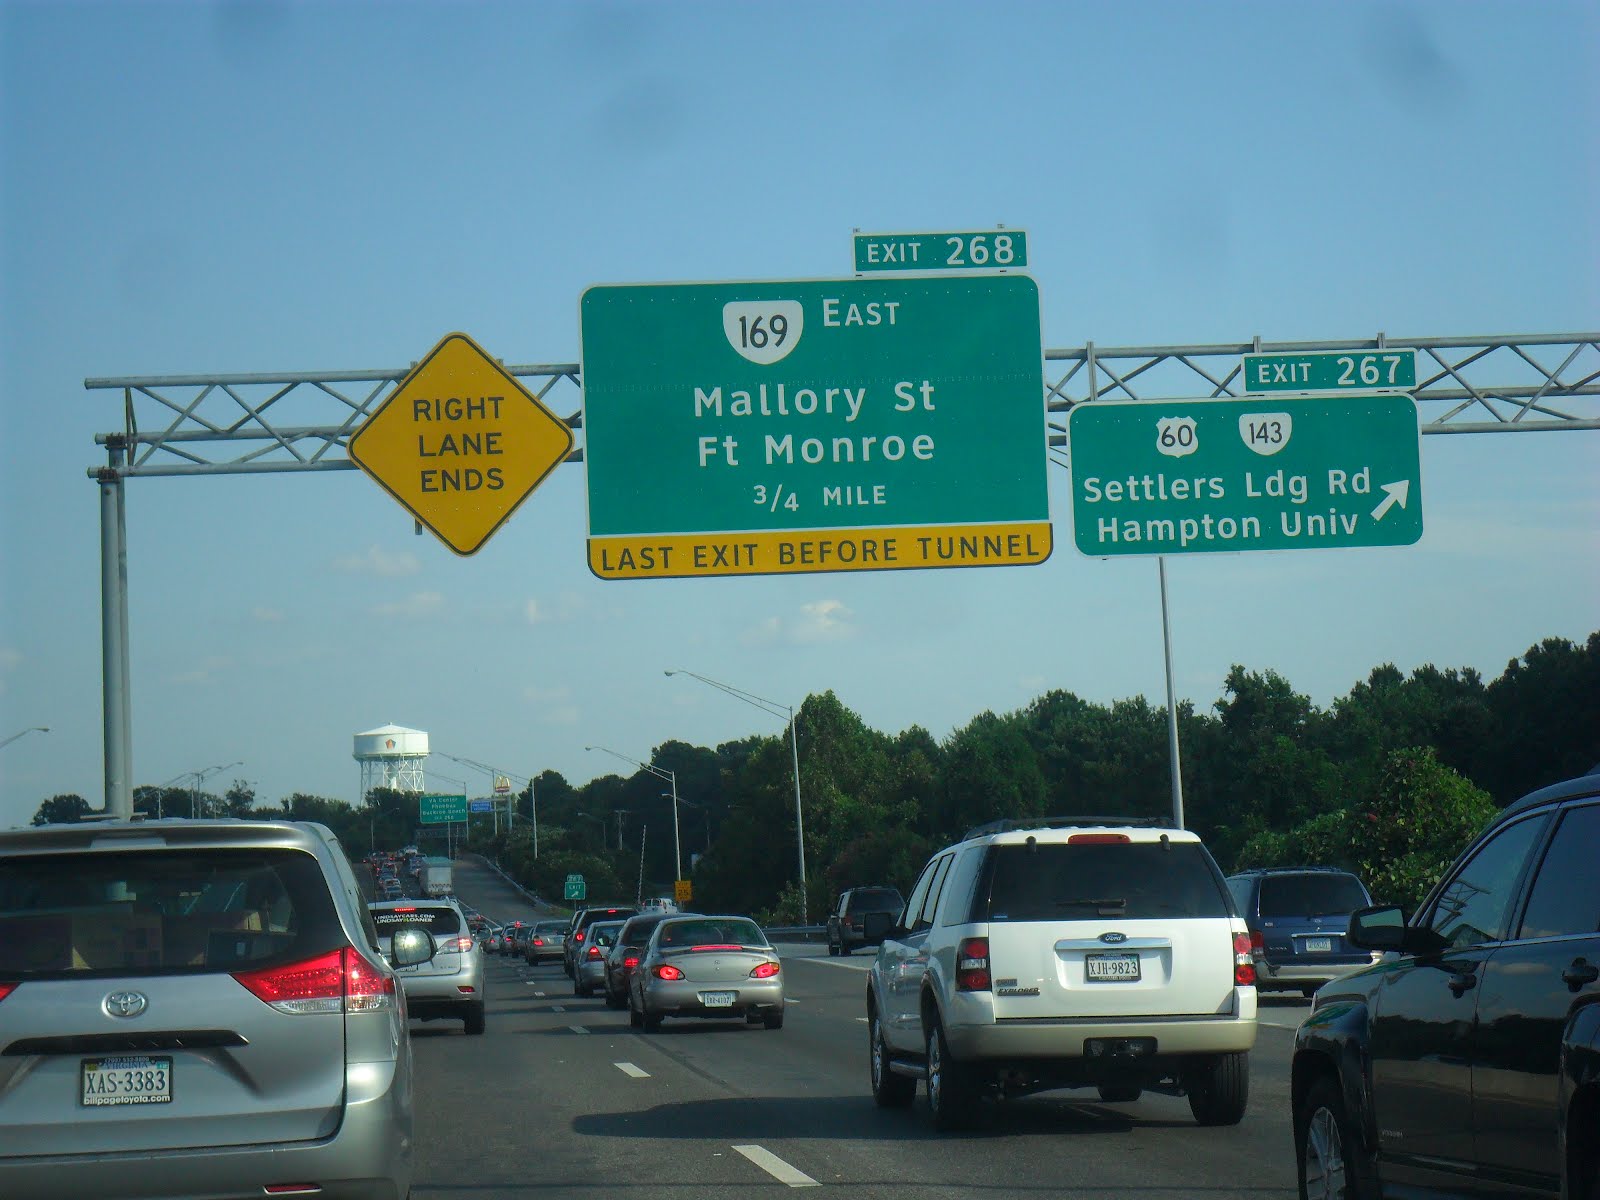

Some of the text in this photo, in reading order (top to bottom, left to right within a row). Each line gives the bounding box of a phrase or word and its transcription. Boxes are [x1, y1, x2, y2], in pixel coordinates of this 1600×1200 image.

[867, 235, 1015, 266] EXIT 268
[739, 298, 900, 350] 169 EAST
[1257, 355, 1402, 385] EXIT 267
[413, 396, 505, 422] RIGHT
[693, 381, 937, 421] Mallory St
[418, 432, 503, 457] LANE
[1160, 424, 1194, 447] 60
[1248, 421, 1284, 444] 143
[698, 432, 936, 467] Ft Monroe
[420, 468, 504, 493] ENDS
[1083, 466, 1371, 503] Settlers Ldg Rd
[752, 484, 887, 512] 3/4 MILE
[1097, 508, 1359, 547] Hampton Univ
[601, 535, 1040, 573] LAST EXIT BEFORE TUNNEL
[1104, 933, 1123, 941] Ford
[1089, 961, 1138, 975] XJH-9823
[86, 1070, 166, 1094] XAS-3383
[83, 1095, 171, 1106] billpagetoyota.com
